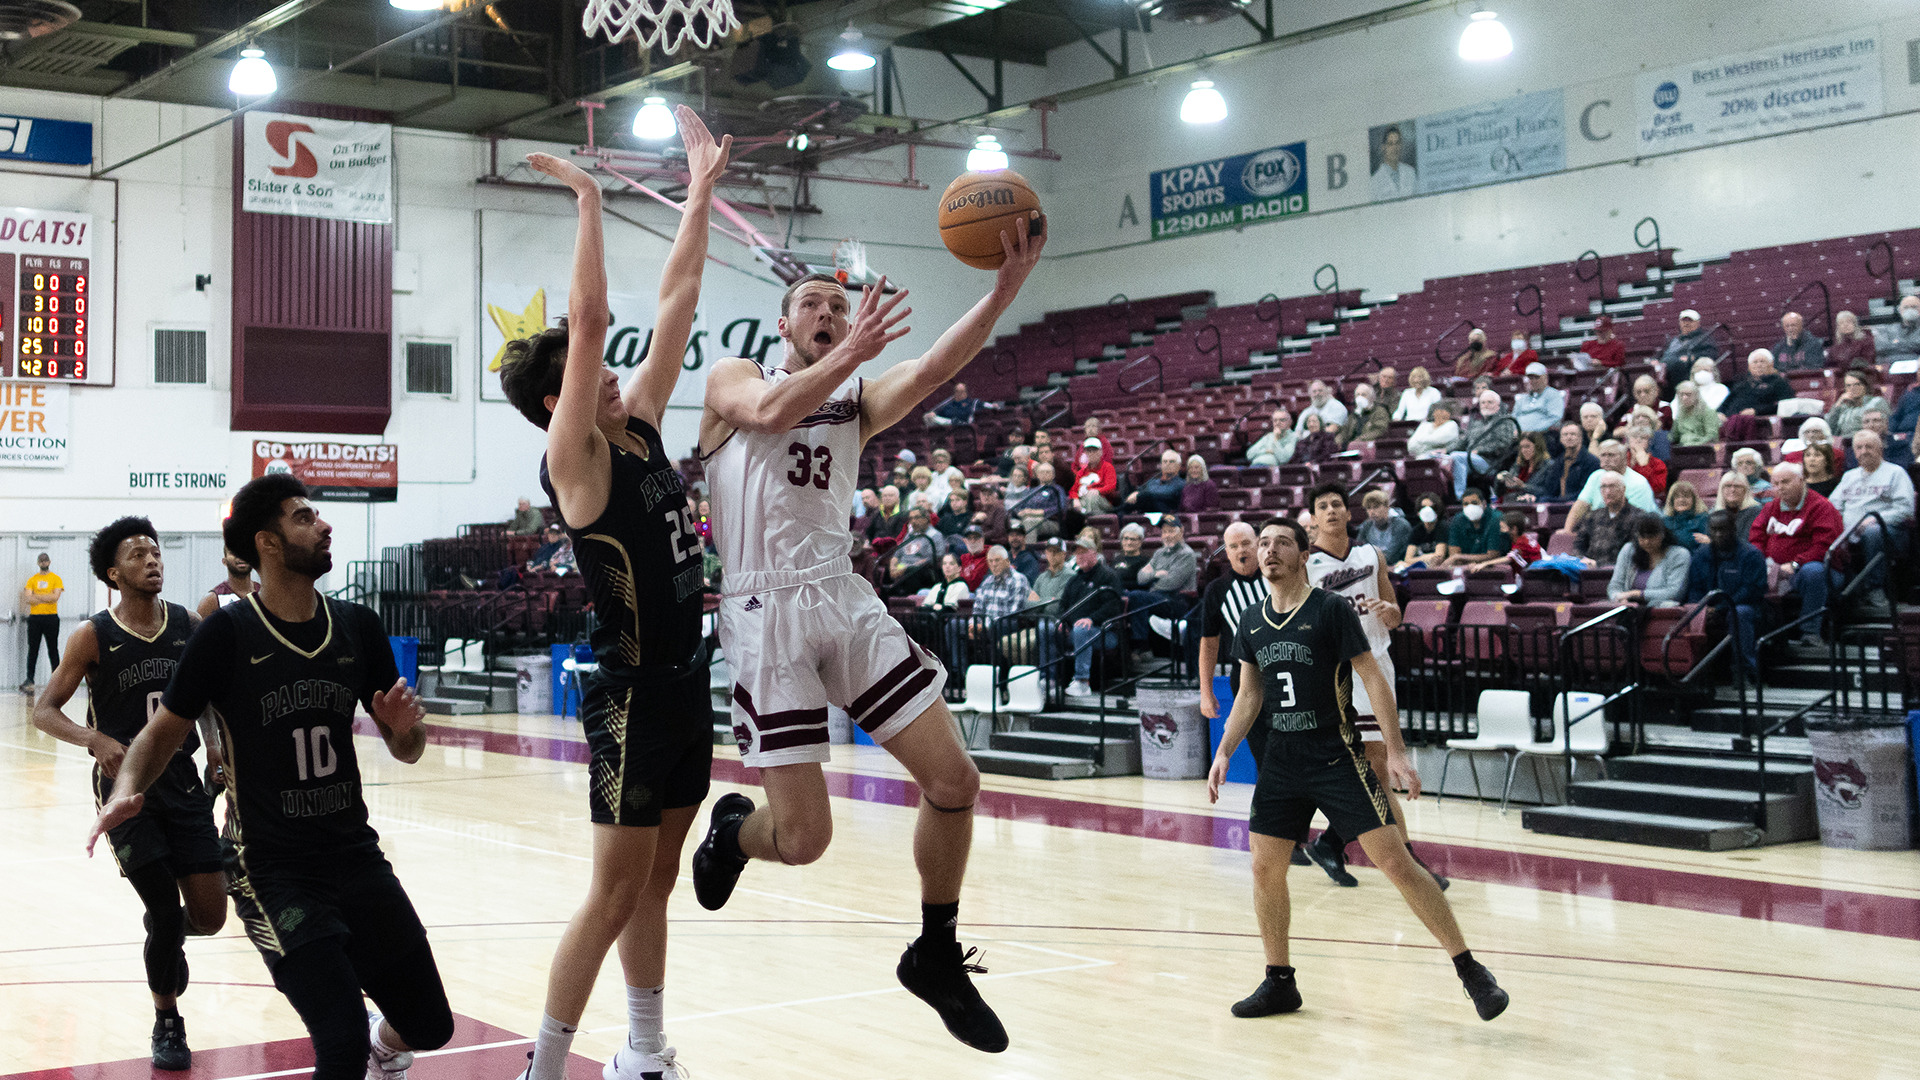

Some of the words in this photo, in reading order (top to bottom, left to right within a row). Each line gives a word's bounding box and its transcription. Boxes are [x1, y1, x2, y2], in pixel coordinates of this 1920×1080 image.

[1720, 97, 1759, 117] 20%
[1763, 81, 1848, 110] discount
[1579, 99, 1613, 142] C
[352, 142, 381, 153] Time
[348, 155, 387, 168] Budget
[1254, 157, 1287, 180] FOX
[1327, 153, 1348, 191] B
[248, 179, 288, 193] Slater
[292, 183, 301, 195] &
[306, 184, 333, 197] Son
[1161, 161, 1225, 195] KPAY
[947, 188, 1016, 213] Wilson
[1118, 194, 1139, 229] A
[1162, 187, 1225, 214] SPORTS
[1241, 195, 1303, 220] RADIO
[49, 258, 61, 269] FLS
[69, 260, 83, 270] PTS
[33, 273, 44, 291] 0
[49, 273, 60, 292] 0
[75, 275, 86, 294] 2
[34, 294, 44, 312] 3
[48, 295, 59, 314] 0
[75, 297, 85, 315] 0
[27, 316, 43, 334] 10
[48, 316, 59, 335] 0
[74, 318, 85, 336] 2
[21, 337, 43, 355] 25
[74, 339, 85, 357] 0
[21, 359, 43, 376] 42
[47, 359, 58, 378] 0
[74, 360, 84, 379] 2
[0, 383, 46, 407] IFE
[23, 453, 59, 461] COMPANY
[255, 441, 286, 459] GO
[291, 443, 396, 462] WILDCATS!
[316, 470, 335, 478] STATE
[335, 471, 371, 479] UNIVERSITY
[787, 441, 833, 490] 33
[129, 472, 170, 488] BUTTE
[174, 472, 226, 488] STRONG
[1256, 641, 1313, 672] PACIFIC
[1276, 671, 1296, 708] 3
[292, 725, 337, 781] 10
[281, 781, 353, 818] UNION
